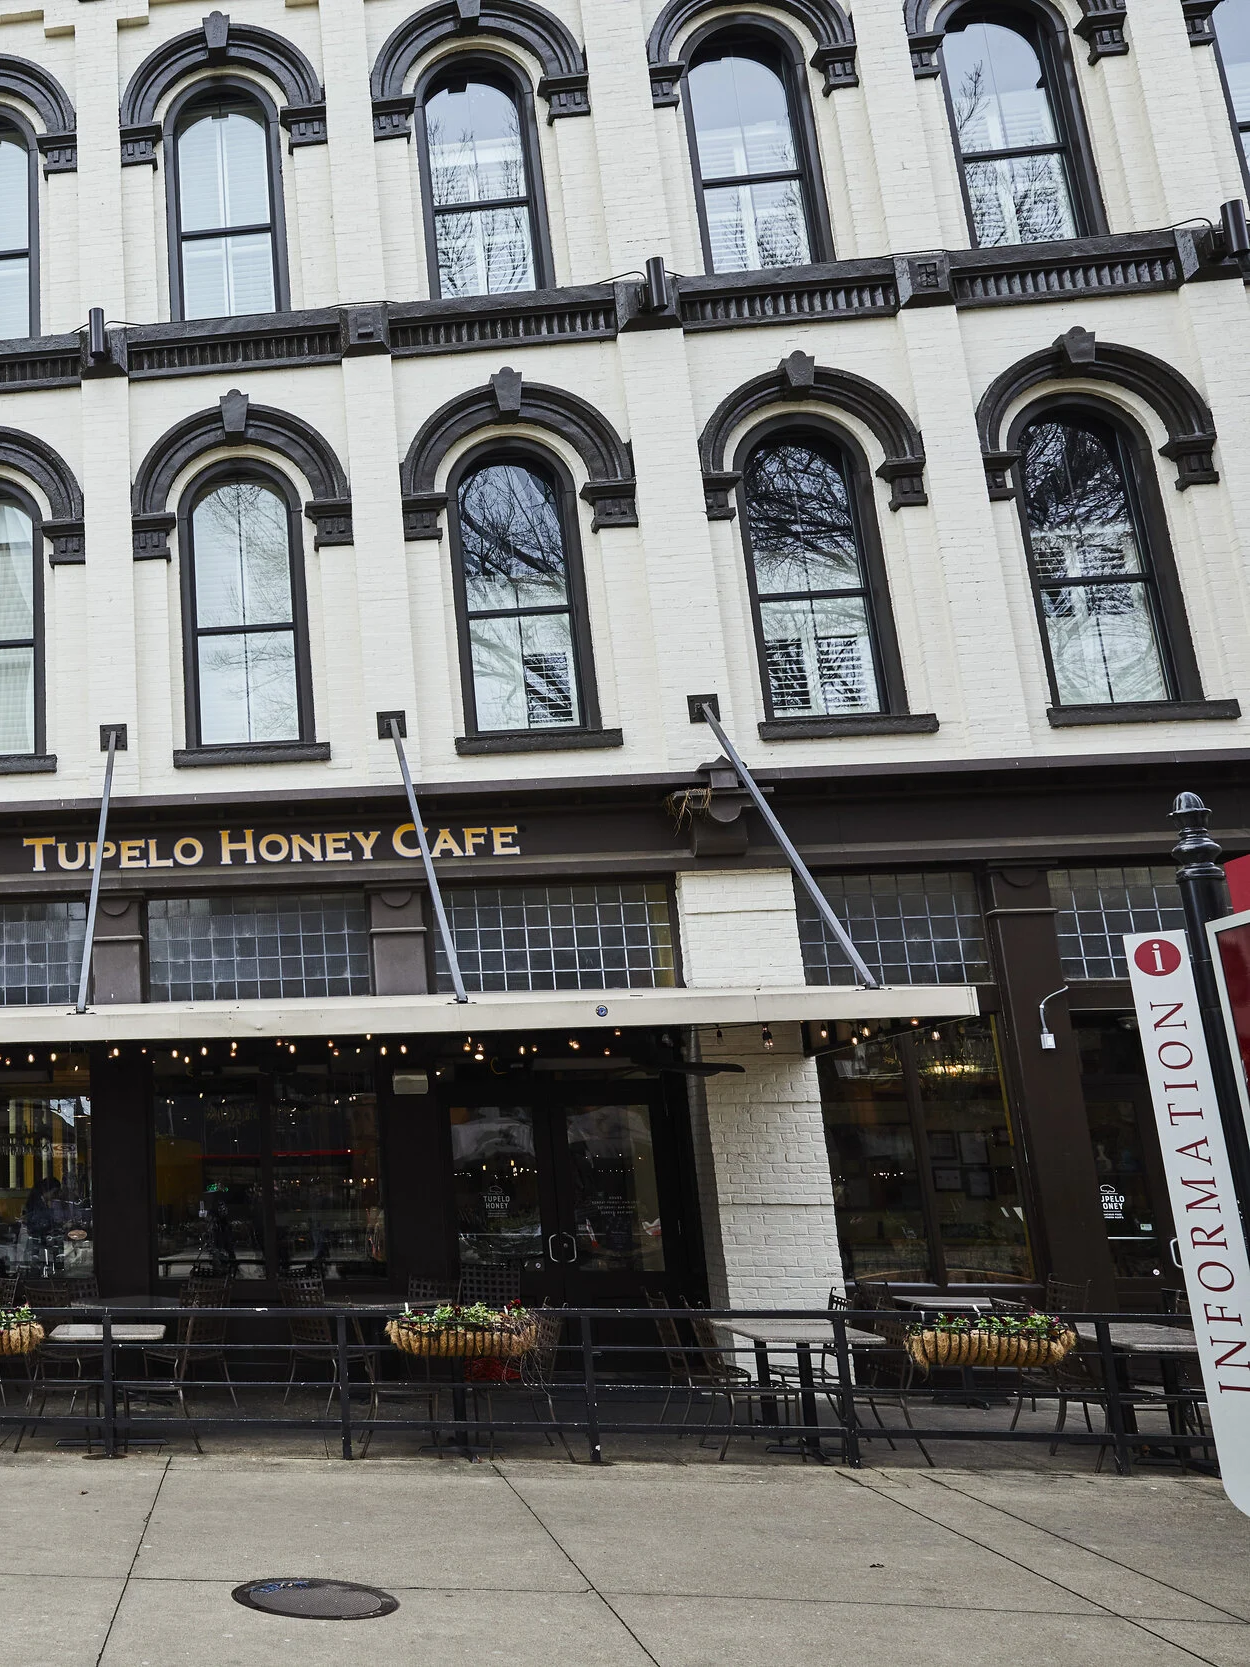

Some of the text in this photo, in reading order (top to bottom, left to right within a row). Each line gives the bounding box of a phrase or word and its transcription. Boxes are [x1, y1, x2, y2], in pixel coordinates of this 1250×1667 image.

[23, 822, 522, 872] TUPELO HONEY CAFE
[483, 1195, 511, 1203] TUPELO
[1150, 1001, 1250, 1394] INFORMATION
